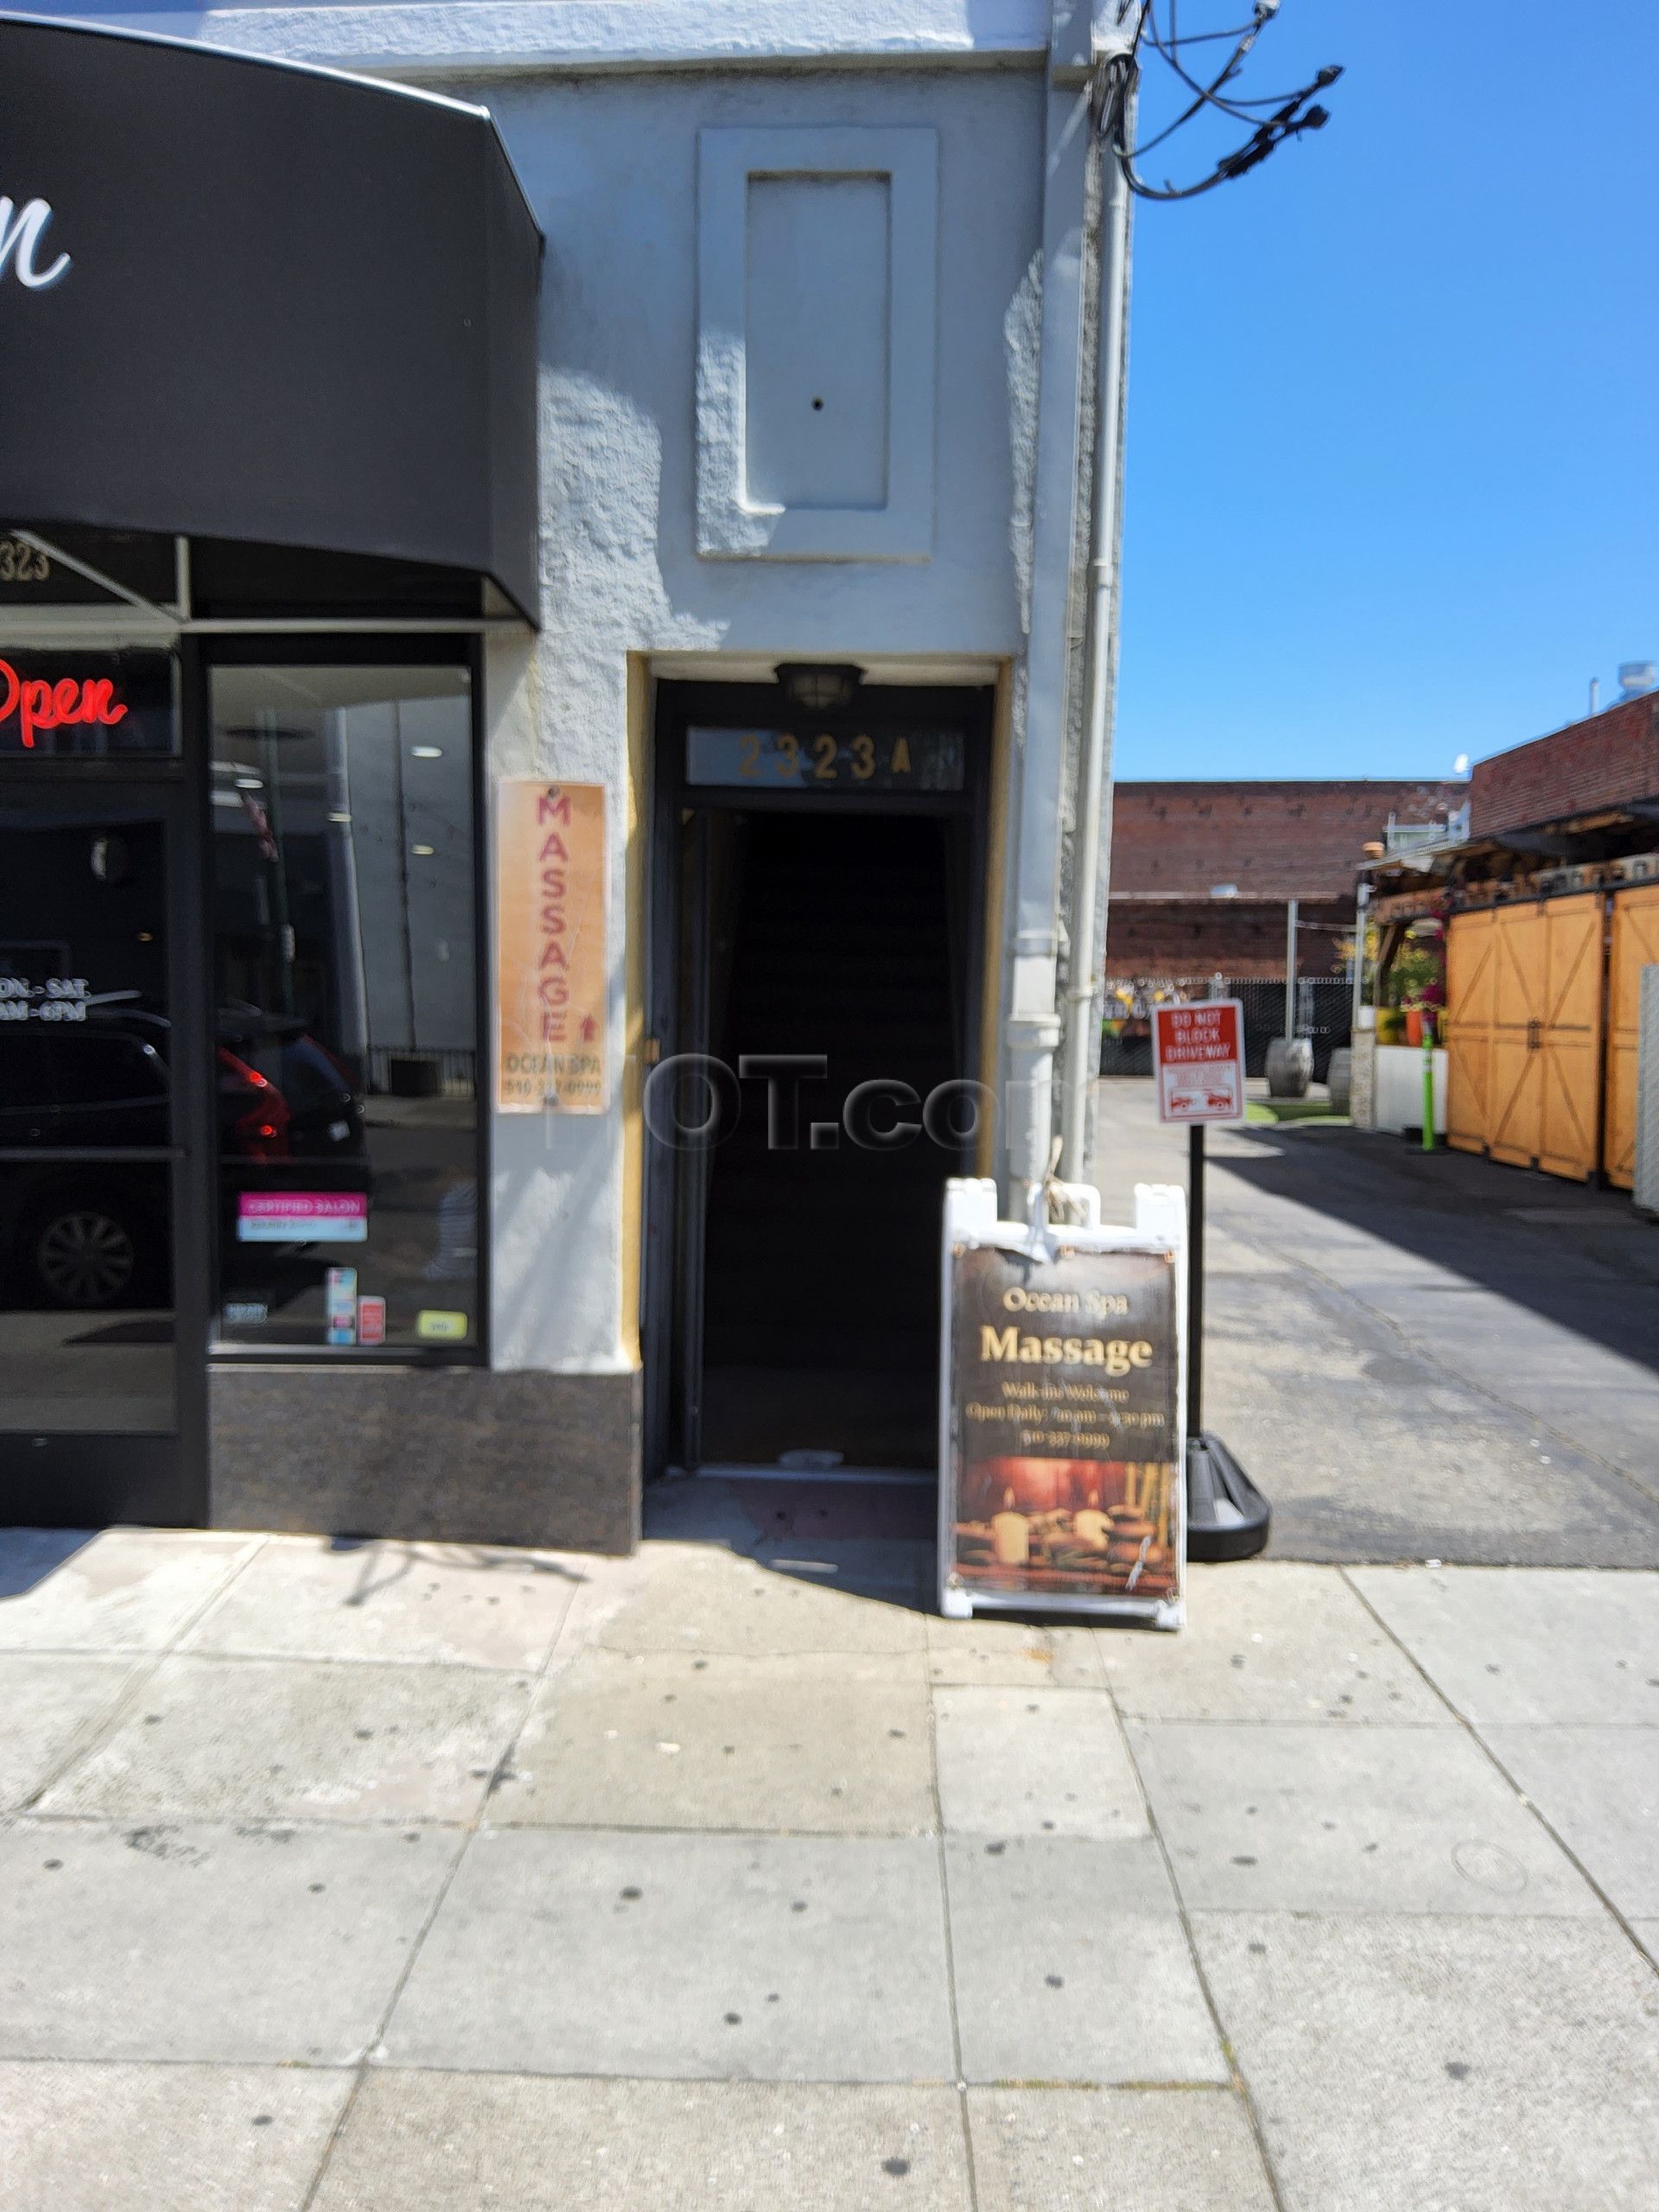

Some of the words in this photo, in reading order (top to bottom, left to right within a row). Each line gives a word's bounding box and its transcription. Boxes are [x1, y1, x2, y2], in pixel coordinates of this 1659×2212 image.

[537, 795, 572, 1042] MASSAGE
[1171, 1011, 1192, 1027] DO
[1194, 1009, 1221, 1027] NOT
[1174, 1027, 1220, 1044] BLOCK
[1166, 1042, 1231, 1061] DRIVEWAY
[1003, 1287, 1080, 1313] Ocean
[1083, 1289, 1128, 1320] Spa
[981, 1325, 1154, 1376] Massage
